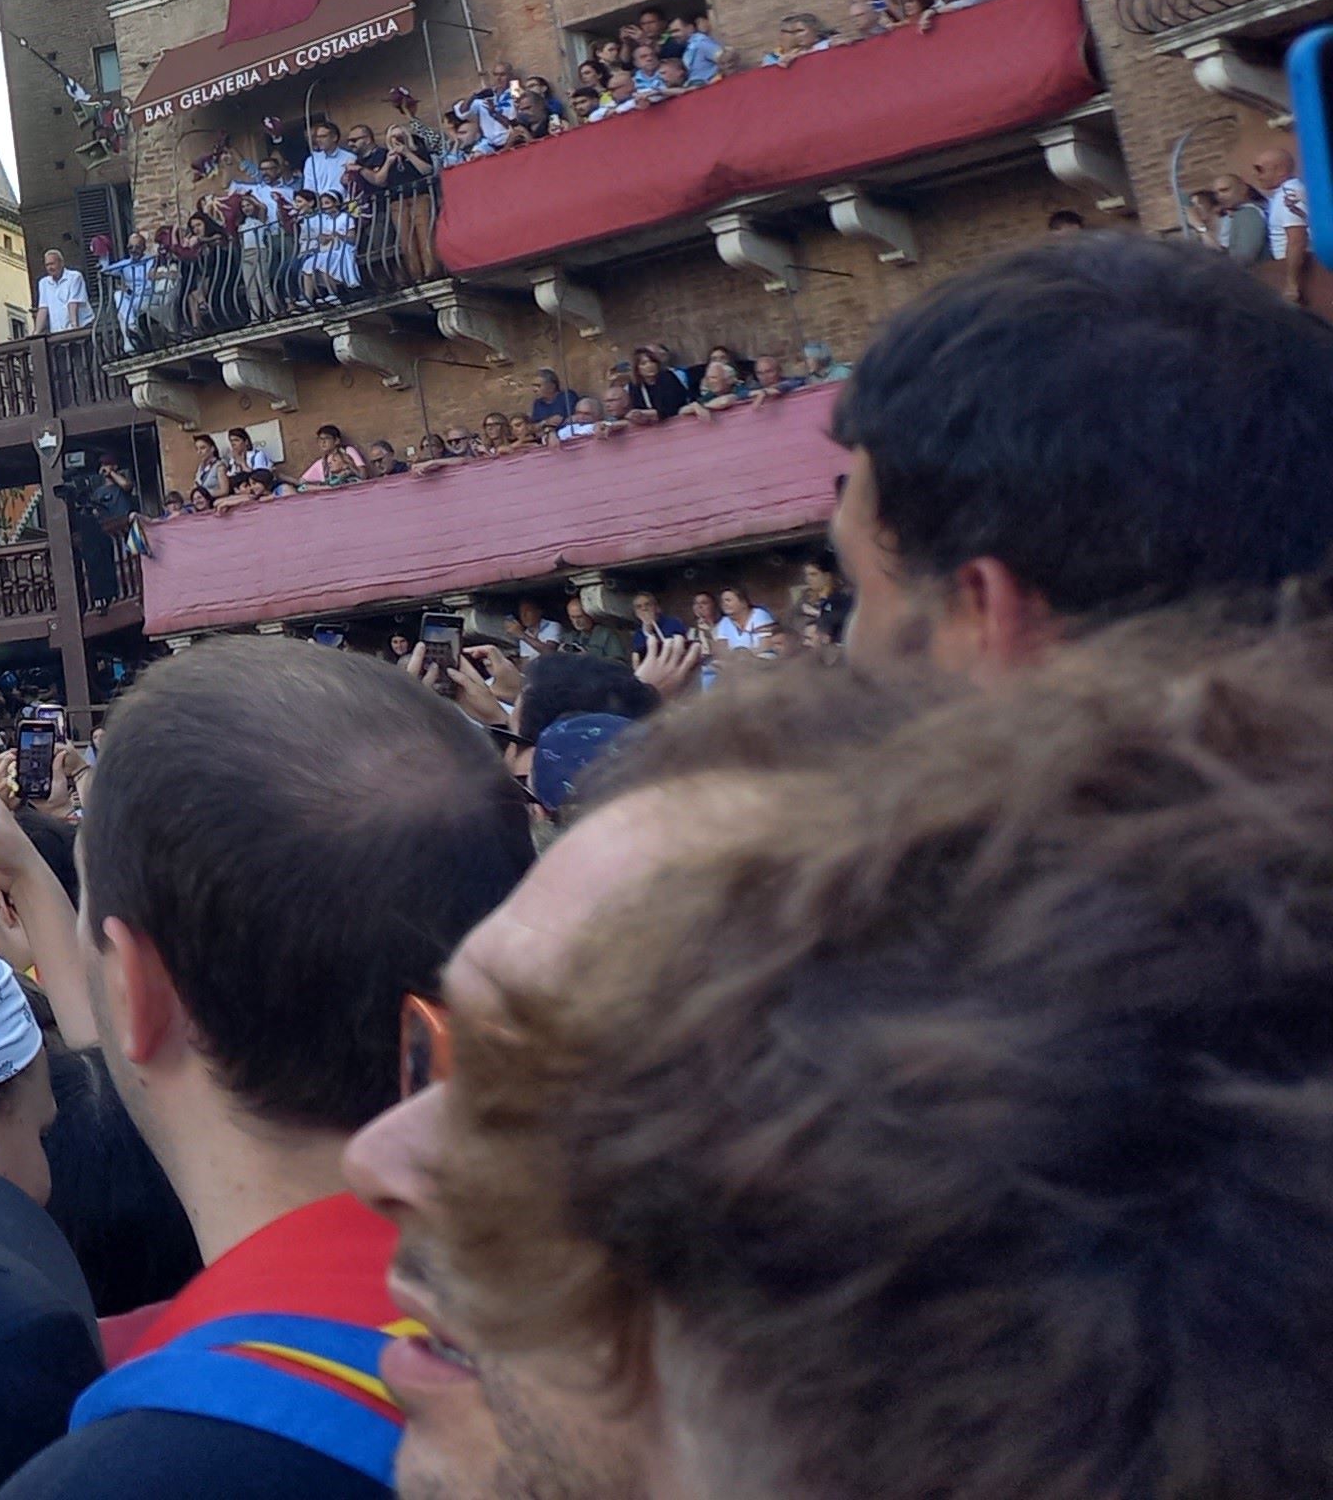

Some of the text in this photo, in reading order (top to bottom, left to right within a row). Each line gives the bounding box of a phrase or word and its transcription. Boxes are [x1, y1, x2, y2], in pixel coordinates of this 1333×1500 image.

[145, 18, 398, 123] BAR GELATERIA LA COSTARELLA
